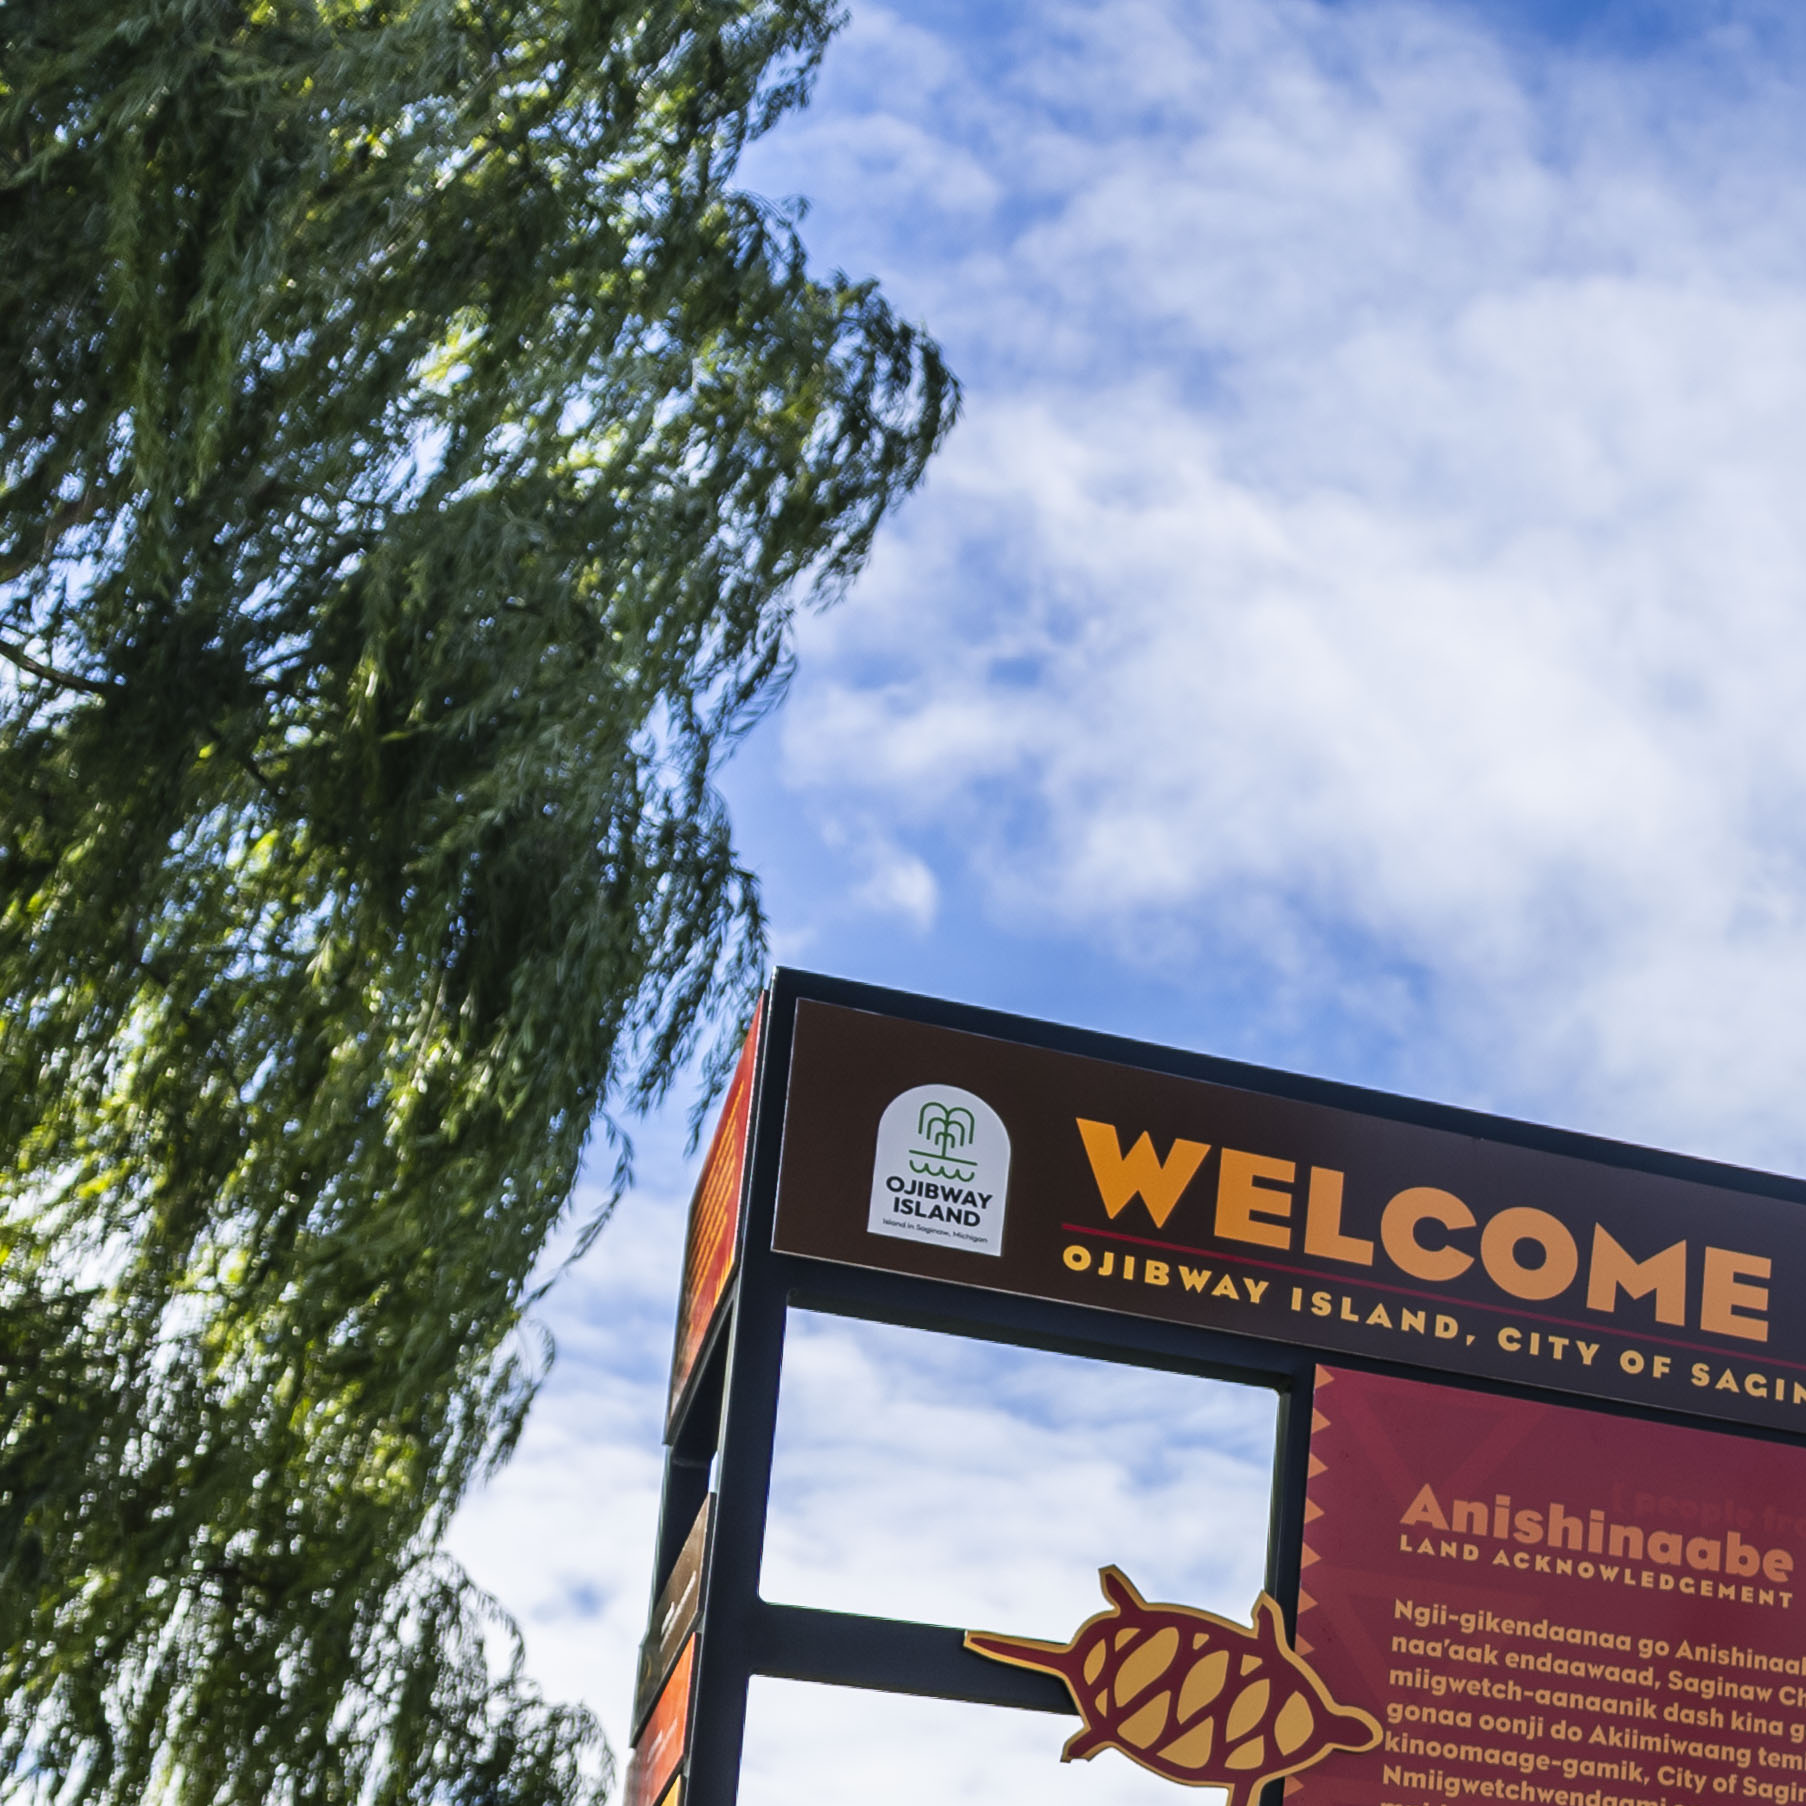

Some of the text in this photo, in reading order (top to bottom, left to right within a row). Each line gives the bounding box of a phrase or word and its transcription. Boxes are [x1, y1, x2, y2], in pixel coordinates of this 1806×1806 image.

[886, 1175, 993, 1210] OJIBWAY
[893, 1196, 981, 1228] ISLAND
[882, 1217, 906, 1229] Island
[953, 1230, 988, 1244] Michigan
[1075, 1117, 1772, 1342] WELCOME
[1062, 1245, 1269, 1304] OJIBWAY
[1291, 1287, 1476, 1347] ISLAND,
[1498, 1327, 1599, 1365] CITY
[1620, 1350, 1671, 1378] OF
[1400, 1482, 1794, 1583] Anishinaabe
[1399, 1533, 1793, 1609] LAND ACKNOWLEDGEMENT
[1394, 1598, 1632, 1652] Ngii-gikendaanaa
[1637, 1638, 1670, 1659] go
[1389, 1667, 1658, 1720] miigwetch-aanaanik
[1662, 1701, 1725, 1729] dash
[1730, 1709, 1784, 1737] kina
[1504, 1651, 1662, 1691] endaawaad,
[1667, 1669, 1774, 1703] Saginaw
[1384, 1730, 1651, 1786] kinoomaage-gamik,
[1656, 1765, 1708, 1795] City
[1712, 1773, 1738, 1794] of
[1386, 1702, 1473, 1729] gonaa
[1478, 1714, 1544, 1741] oonji
[1549, 1719, 1583, 1743] do
[1587, 1724, 1752, 1769] Akiimiwaang
